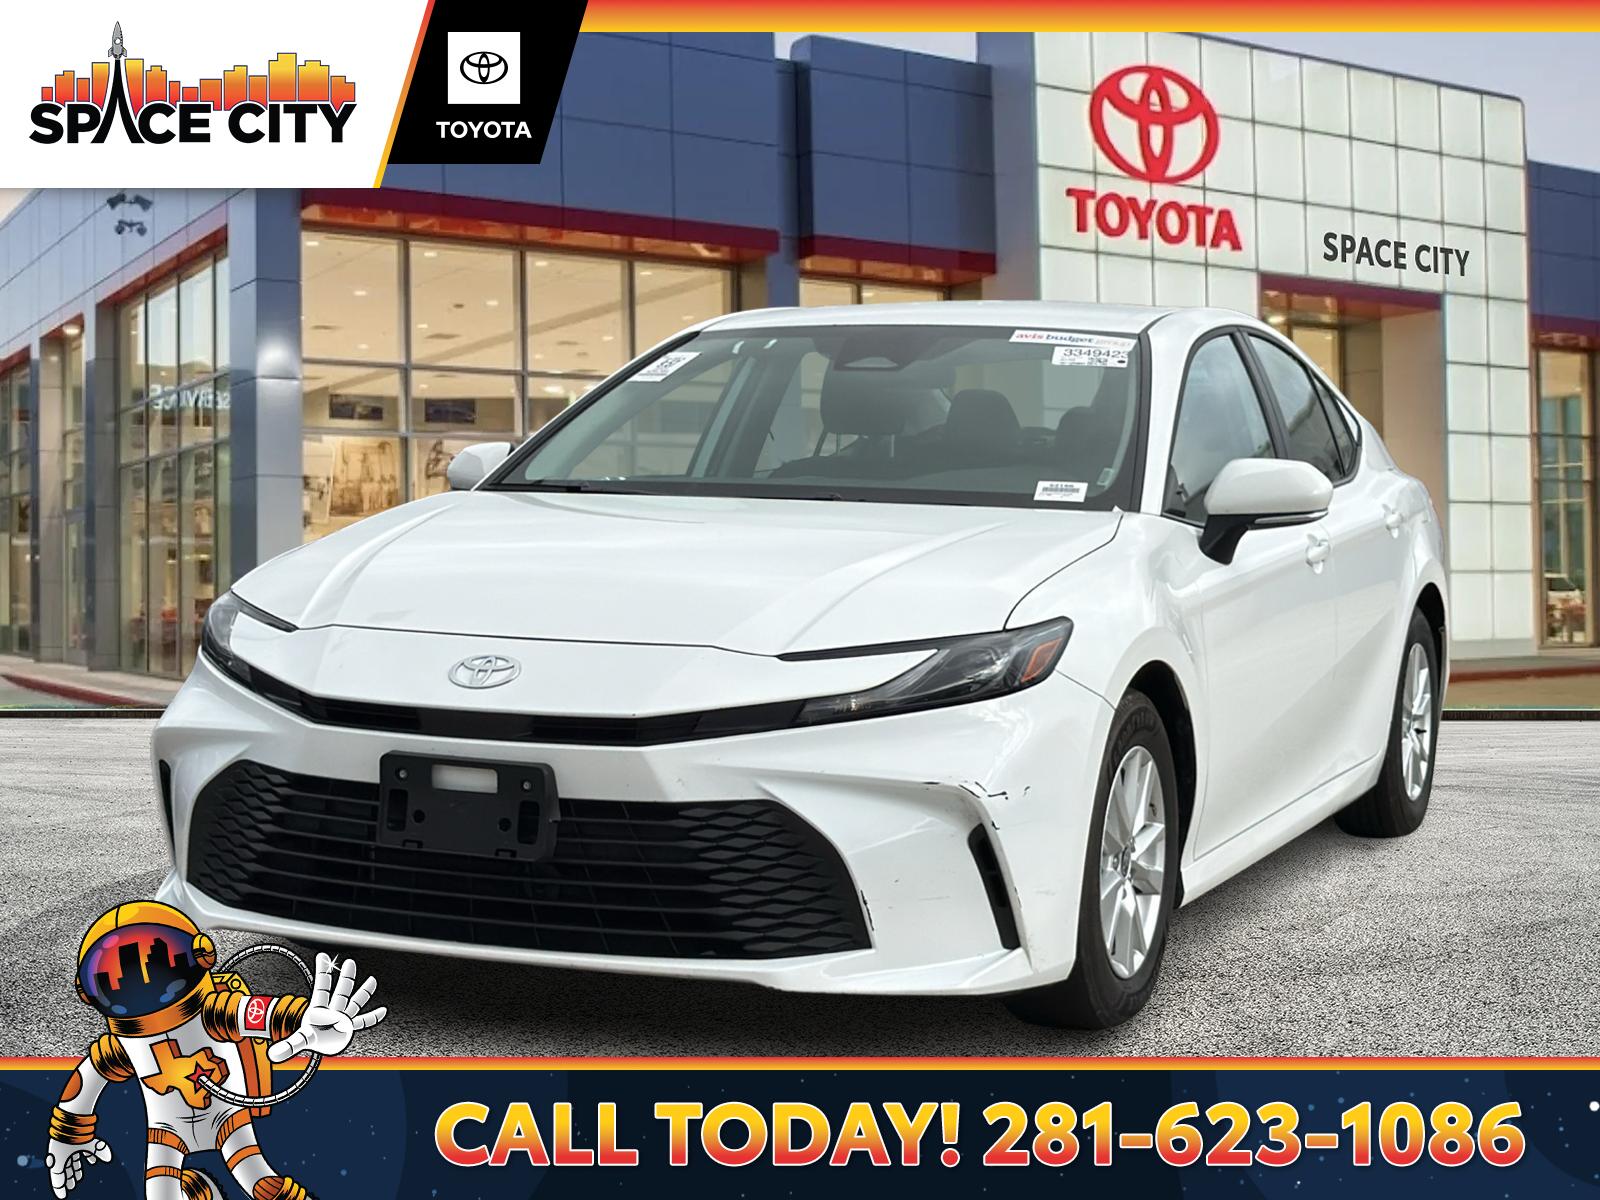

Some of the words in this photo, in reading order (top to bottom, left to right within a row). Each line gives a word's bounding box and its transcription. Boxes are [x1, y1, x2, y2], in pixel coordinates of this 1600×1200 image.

[1066, 187, 1242, 251] TOYOTA
[1322, 231, 1407, 270] SPACE
[1414, 244, 1471, 277] CITY
[1046, 334, 1094, 343] budget
